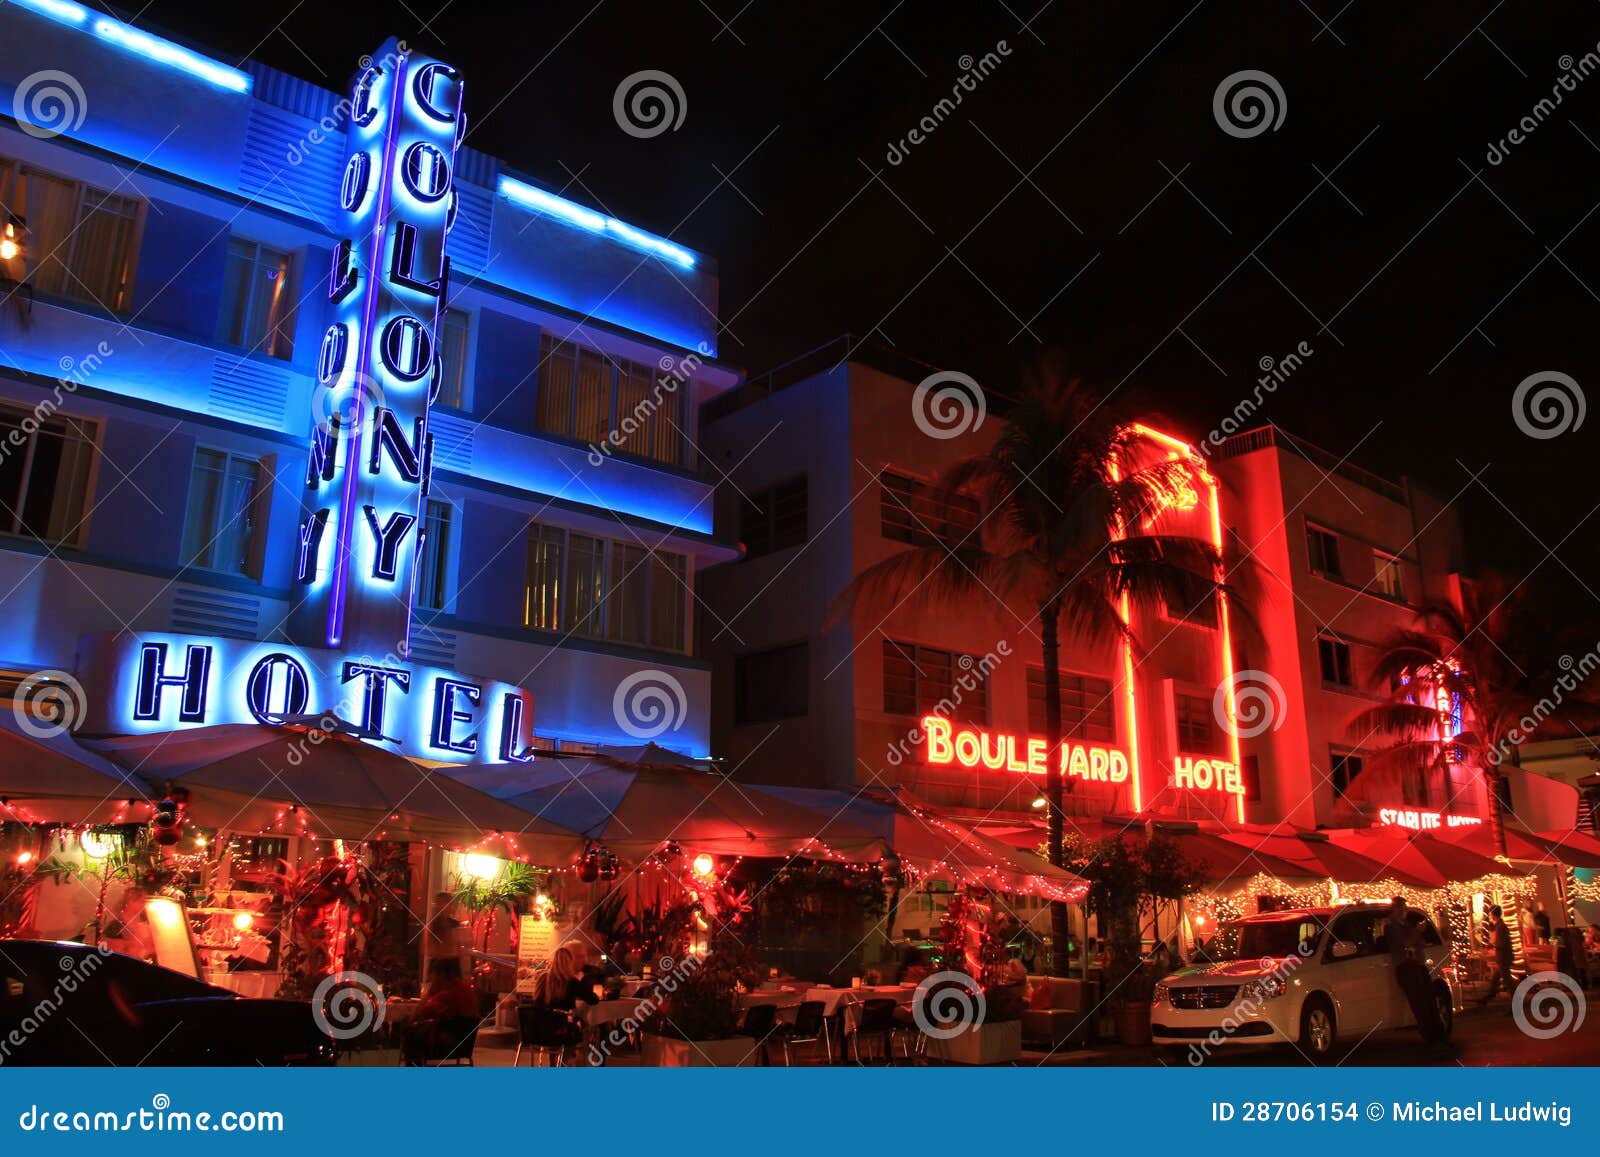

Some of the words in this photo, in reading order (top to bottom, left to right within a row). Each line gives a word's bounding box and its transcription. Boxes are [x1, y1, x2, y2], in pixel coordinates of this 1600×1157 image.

[299, 66, 384, 585] COLONY
[363, 62, 464, 582] COLONY
[132, 642, 535, 763] HOTEL
[1174, 757, 1245, 794] HOTEL
